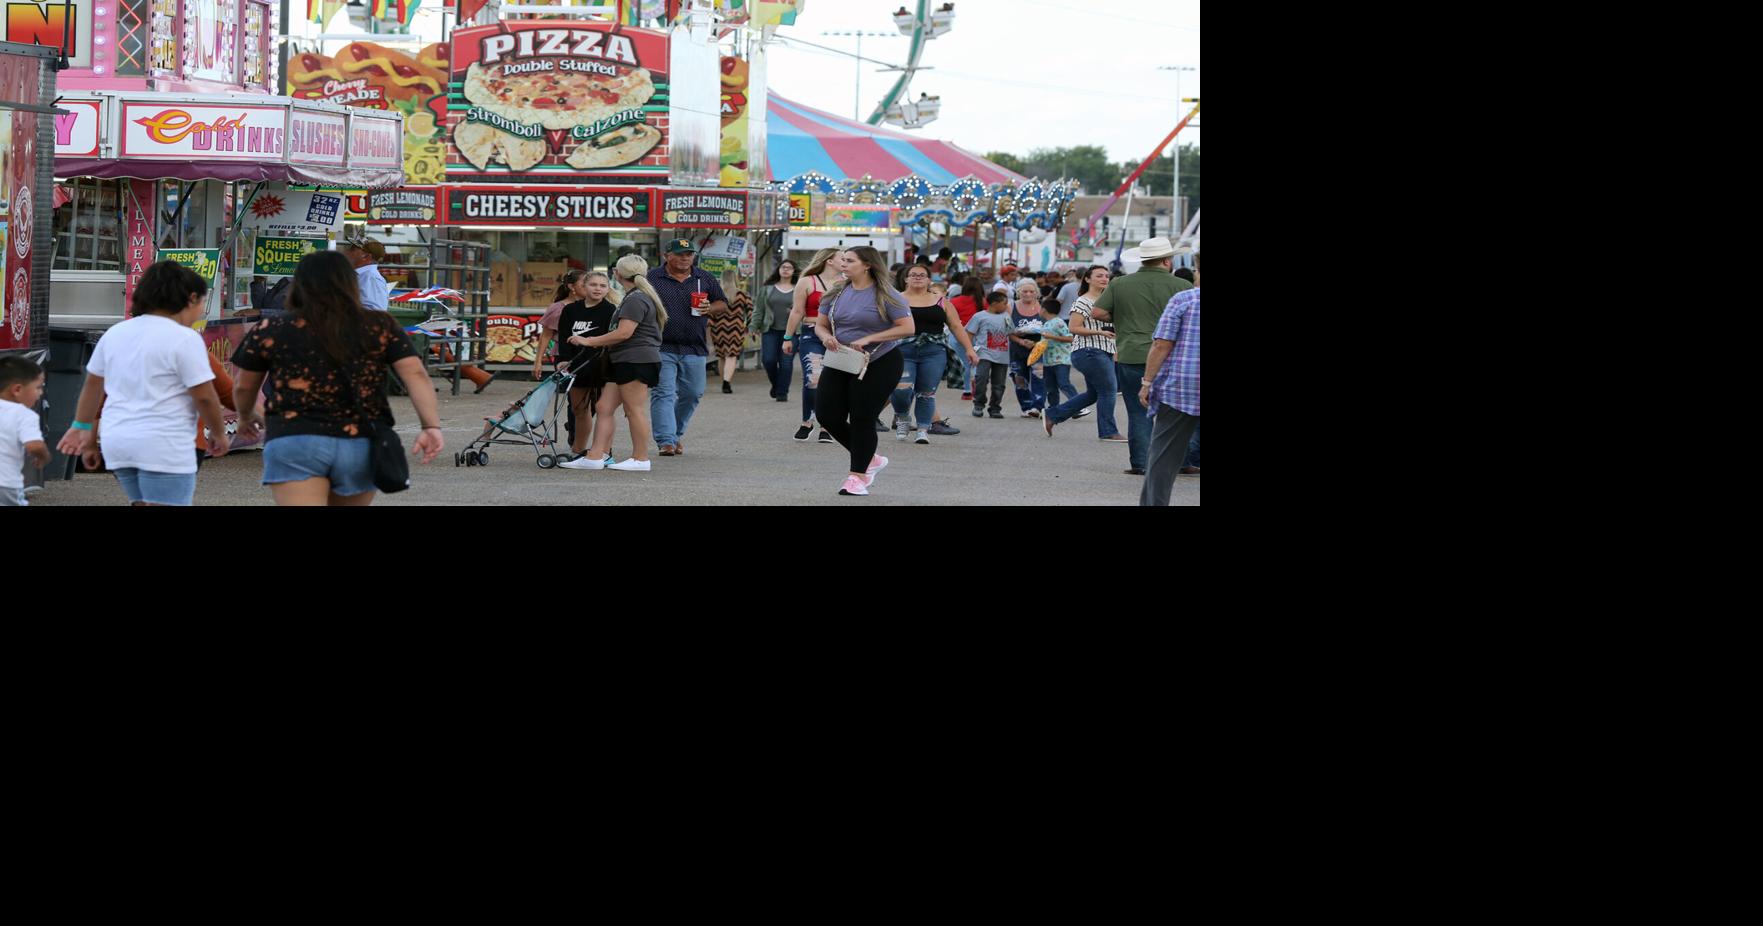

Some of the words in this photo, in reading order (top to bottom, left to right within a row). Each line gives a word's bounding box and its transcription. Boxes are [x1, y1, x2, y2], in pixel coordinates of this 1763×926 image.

[483, 29, 637, 64] PIZZA
[504, 60, 554, 76] Double
[560, 59, 616, 77] Stuffed
[324, 79, 367, 96] Cherry
[133, 109, 247, 144] Cold
[467, 107, 542, 138] Stromboli
[573, 108, 644, 139] Calzone
[192, 126, 283, 155] DRINKS
[292, 120, 345, 156] SLUSHES
[313, 195, 328, 204] 32
[371, 192, 394, 207] FRESH
[397, 192, 435, 208] LEMONADE
[466, 195, 550, 218] CHEESY
[556, 196, 634, 219] STICKS
[665, 196, 694, 210] FRESH
[697, 195, 743, 212] LEMONADE
[678, 214, 698, 222] COLD
[700, 214, 729, 223] DRINKS
[265, 240, 299, 249] FRESH
[166, 253, 195, 262] FRESH
[487, 318, 520, 326] ouble
[572, 320, 593, 330] NIKE
